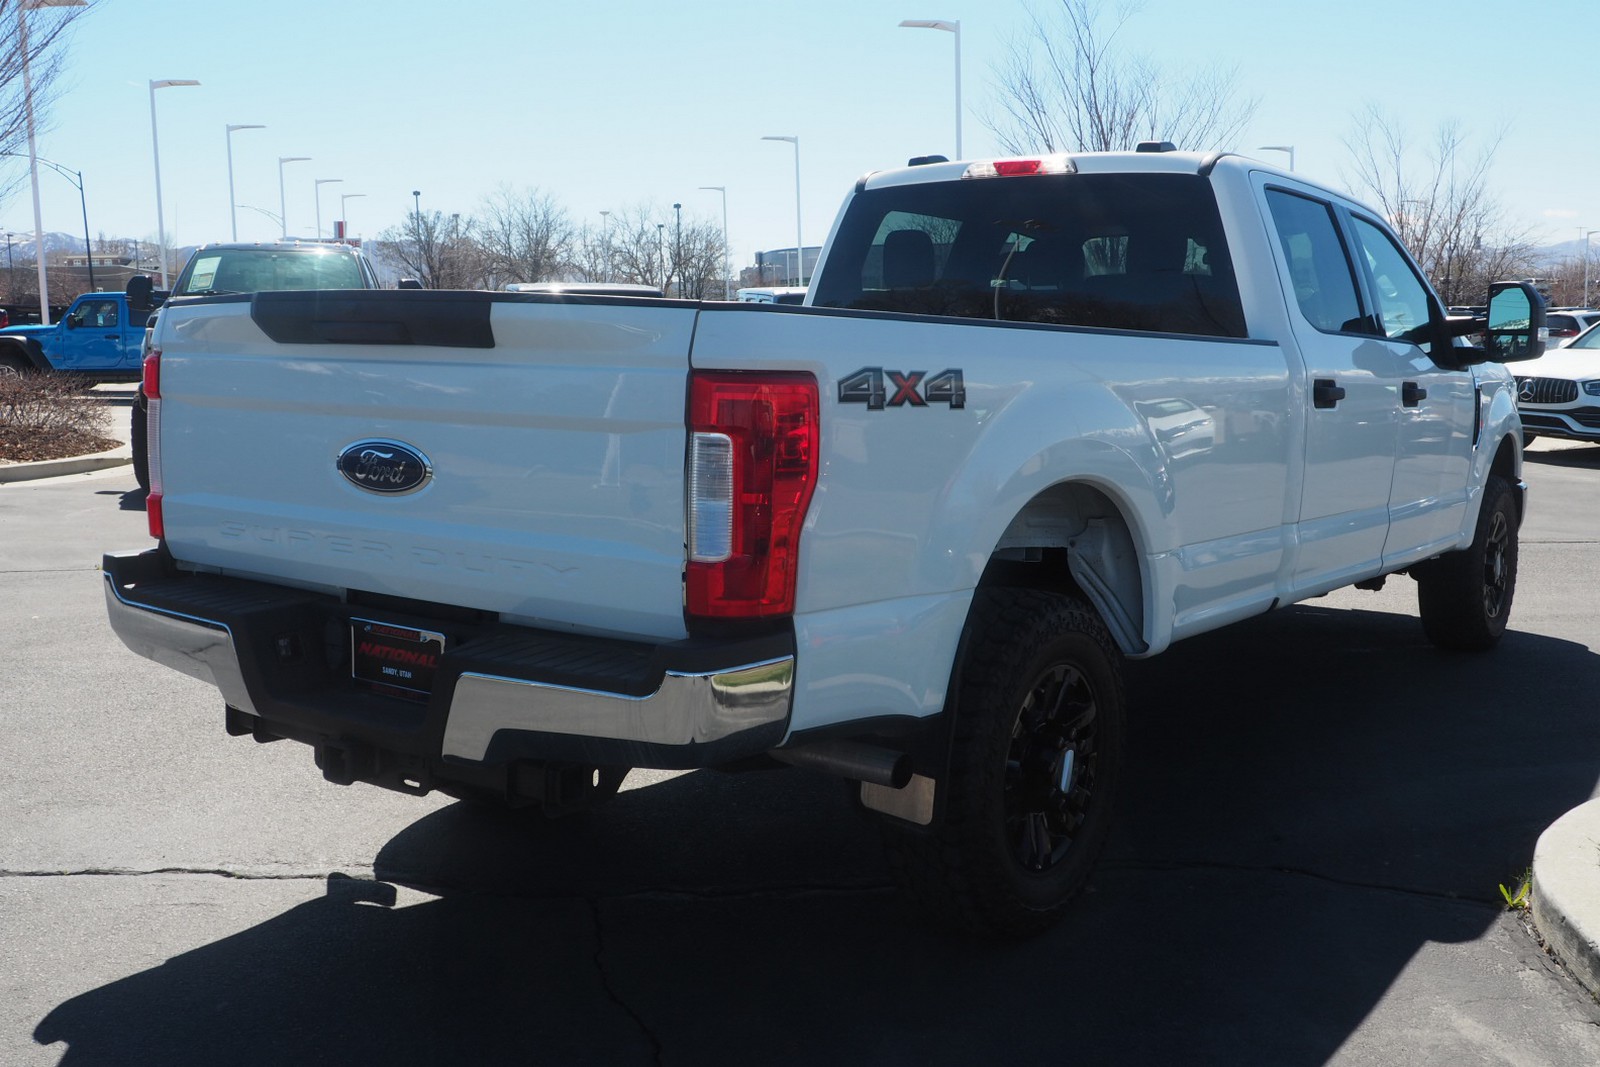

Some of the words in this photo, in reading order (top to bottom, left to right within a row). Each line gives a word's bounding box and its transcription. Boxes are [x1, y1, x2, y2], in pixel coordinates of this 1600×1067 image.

[355, 449, 406, 483] Ford
[219, 519, 393, 561] SUPER
[409, 545, 582, 584] DUTY
[358, 641, 437, 667] NATIONAL
[399, 669, 412, 679] UTAH
